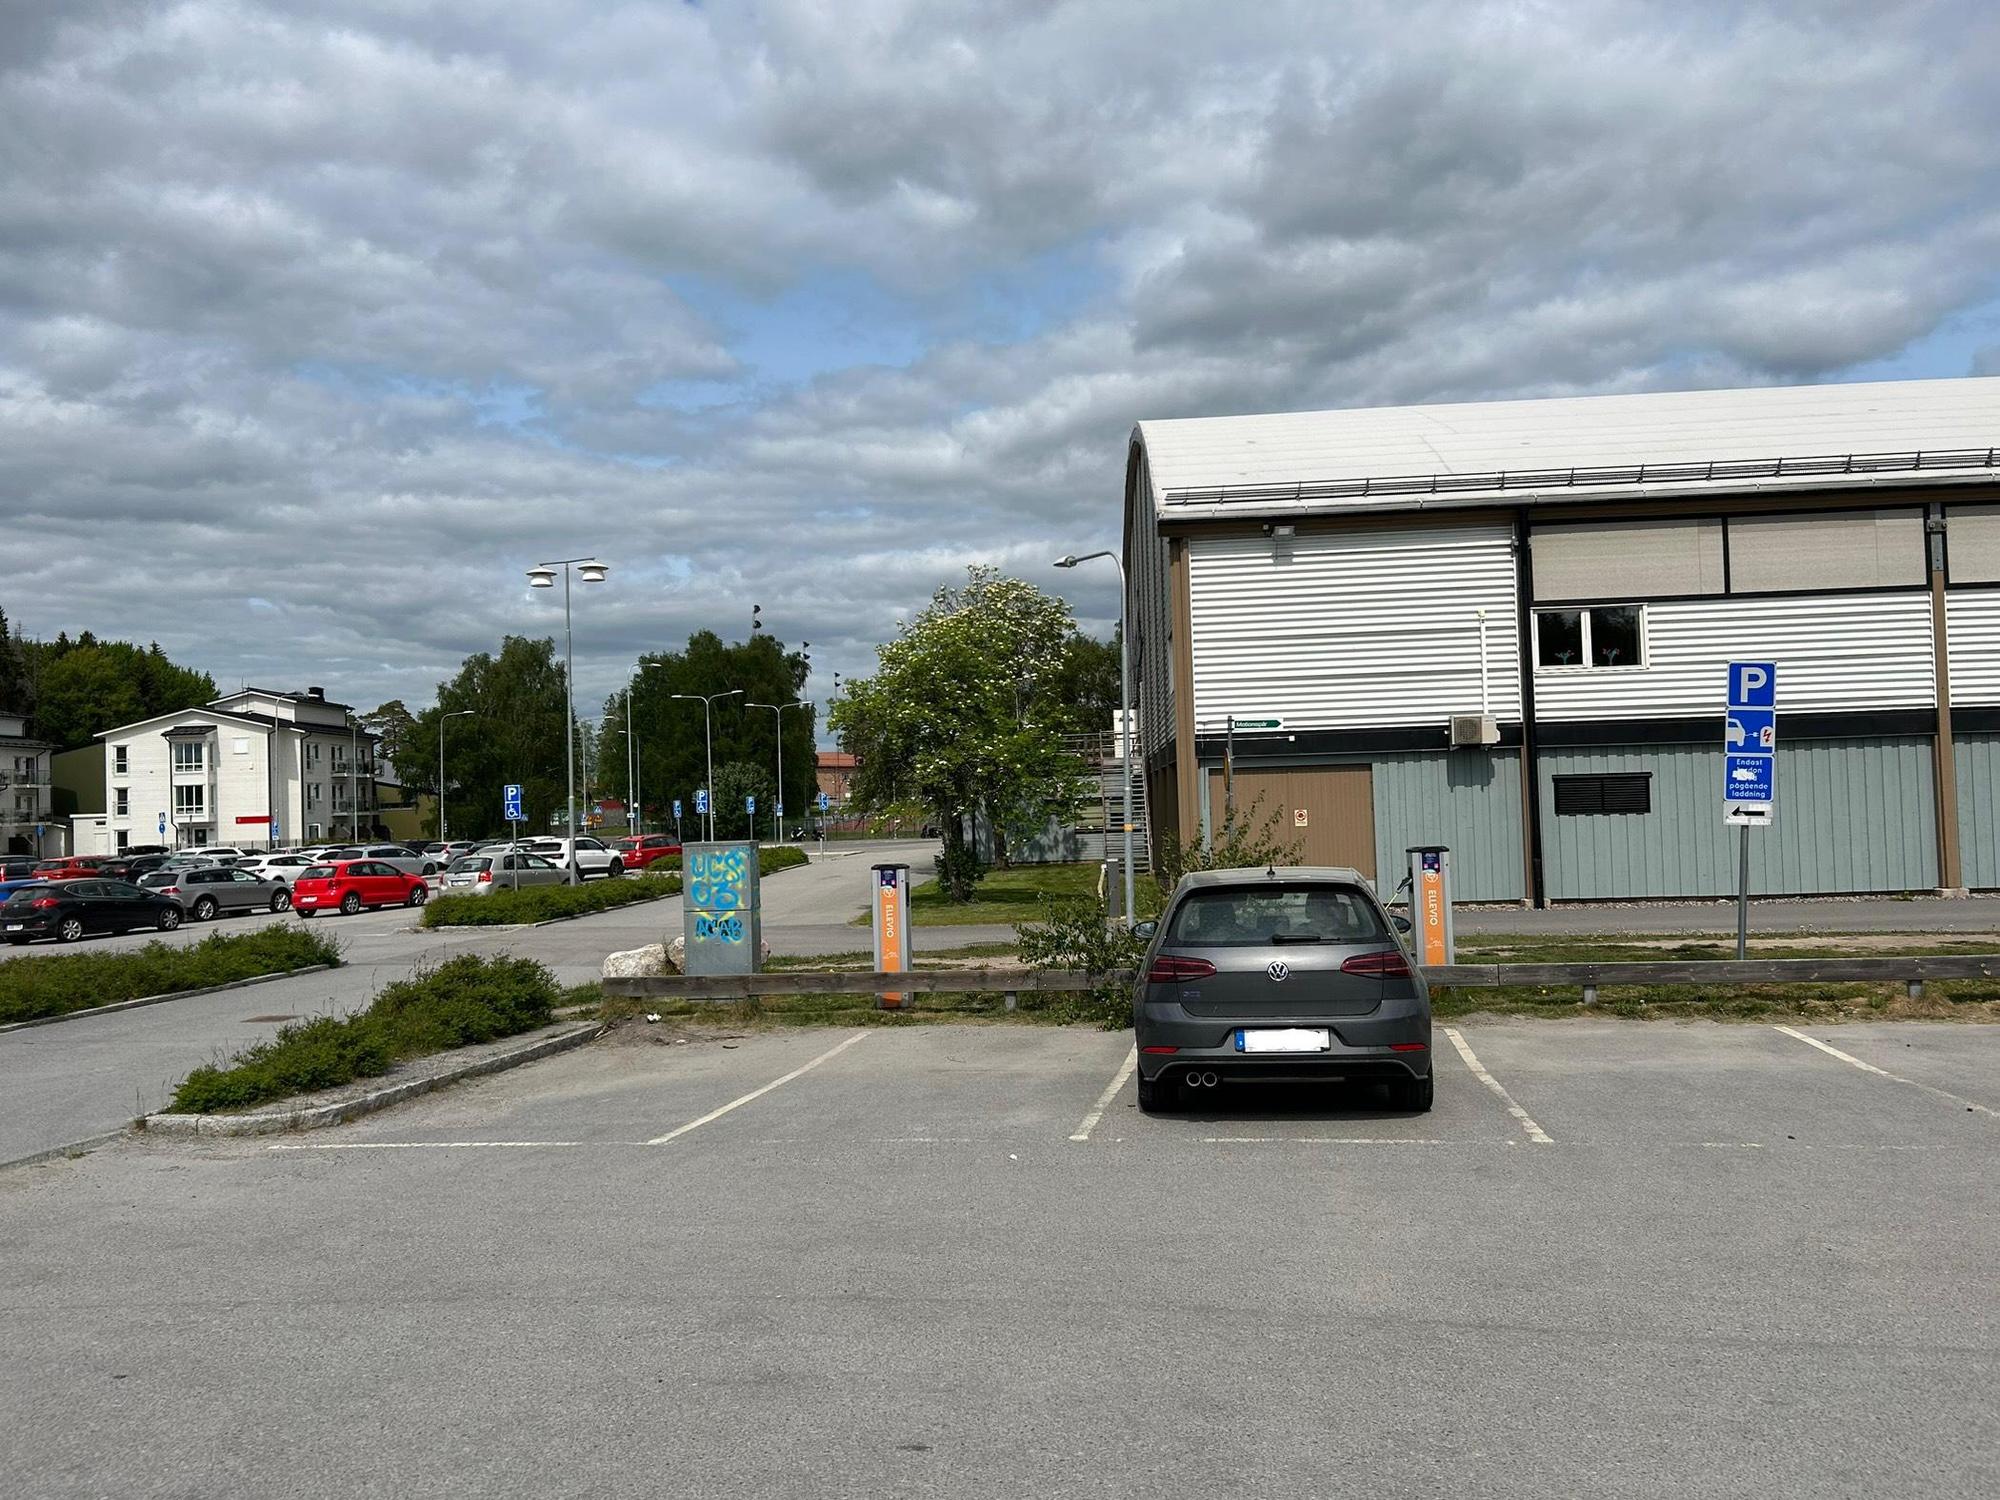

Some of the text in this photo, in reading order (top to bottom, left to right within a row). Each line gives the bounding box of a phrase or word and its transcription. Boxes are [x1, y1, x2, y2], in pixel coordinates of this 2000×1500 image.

[1740, 667, 1767, 703] P
[1736, 758, 1763, 766] Endast
[507, 787, 517, 801] P
[699, 791, 706, 801] P
[1731, 791, 1766, 799] laddning
[1428, 889, 1438, 926] ELLEVIO
[886, 904, 894, 938] ELLEVIO
